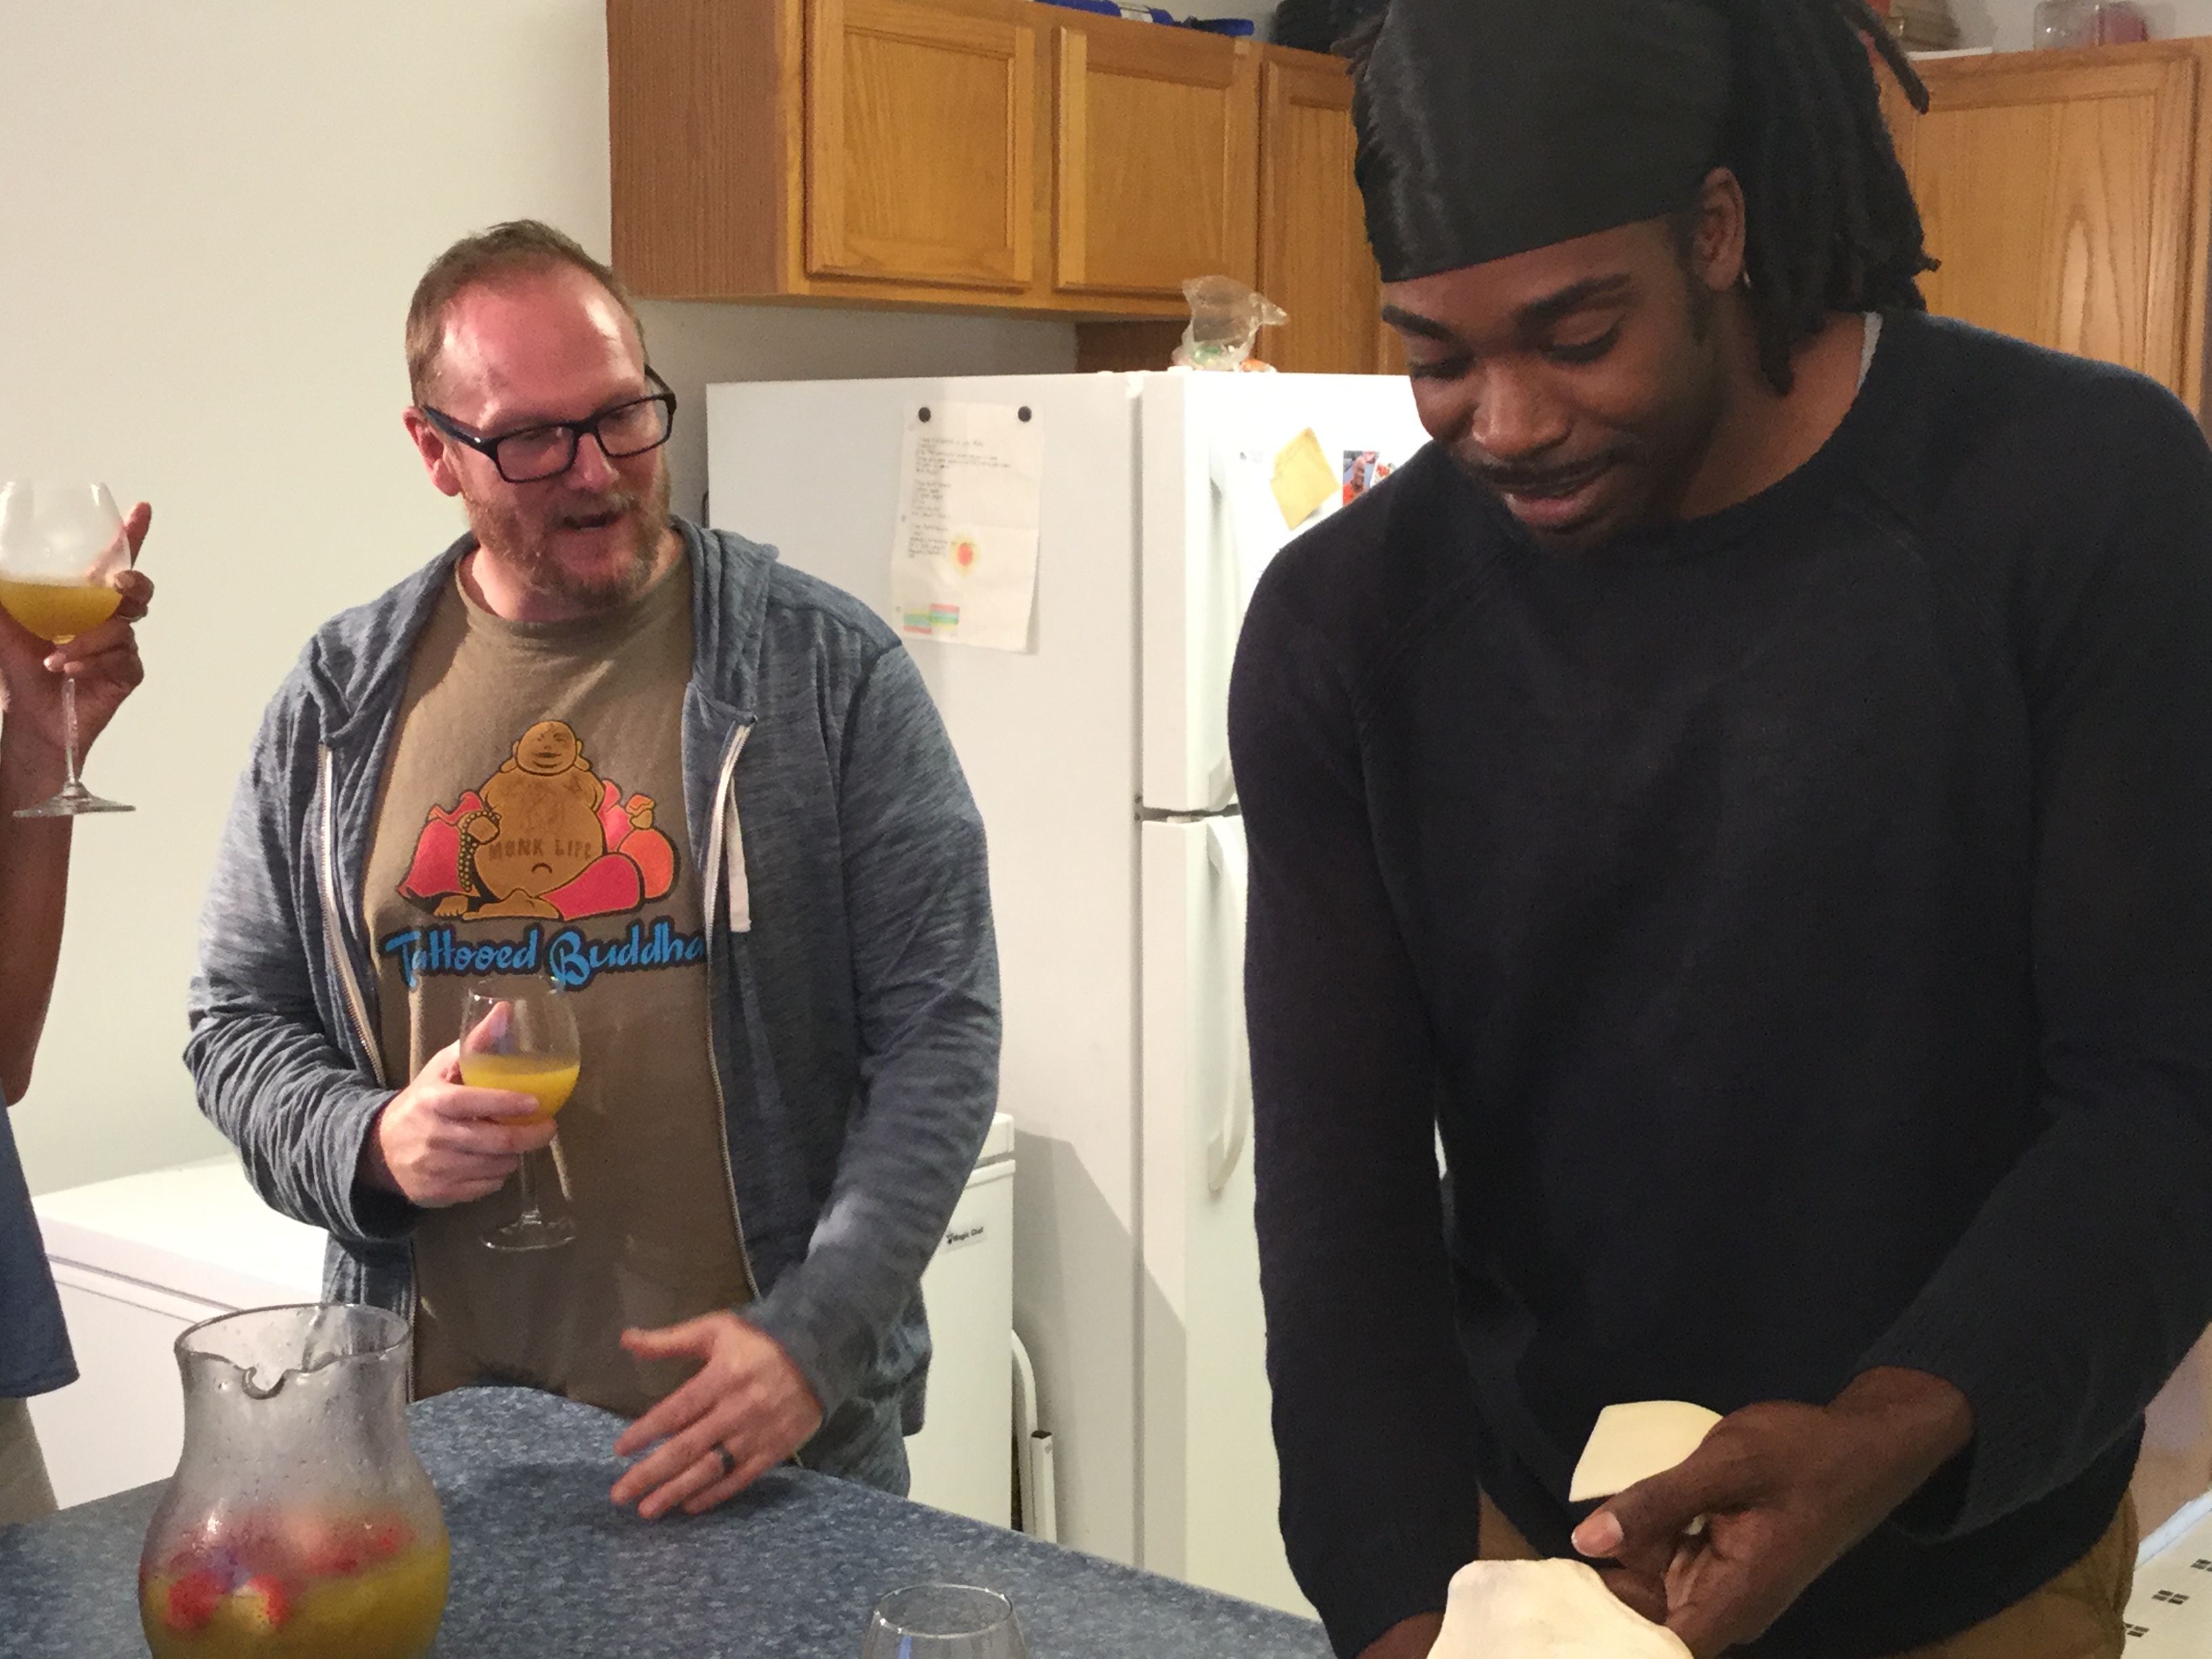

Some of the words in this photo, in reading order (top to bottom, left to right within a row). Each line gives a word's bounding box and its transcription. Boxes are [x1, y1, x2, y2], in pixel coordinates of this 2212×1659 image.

[489, 837, 544, 861] MONK
[385, 928, 538, 987] Tattooed
[549, 922, 704, 986] Buddha
